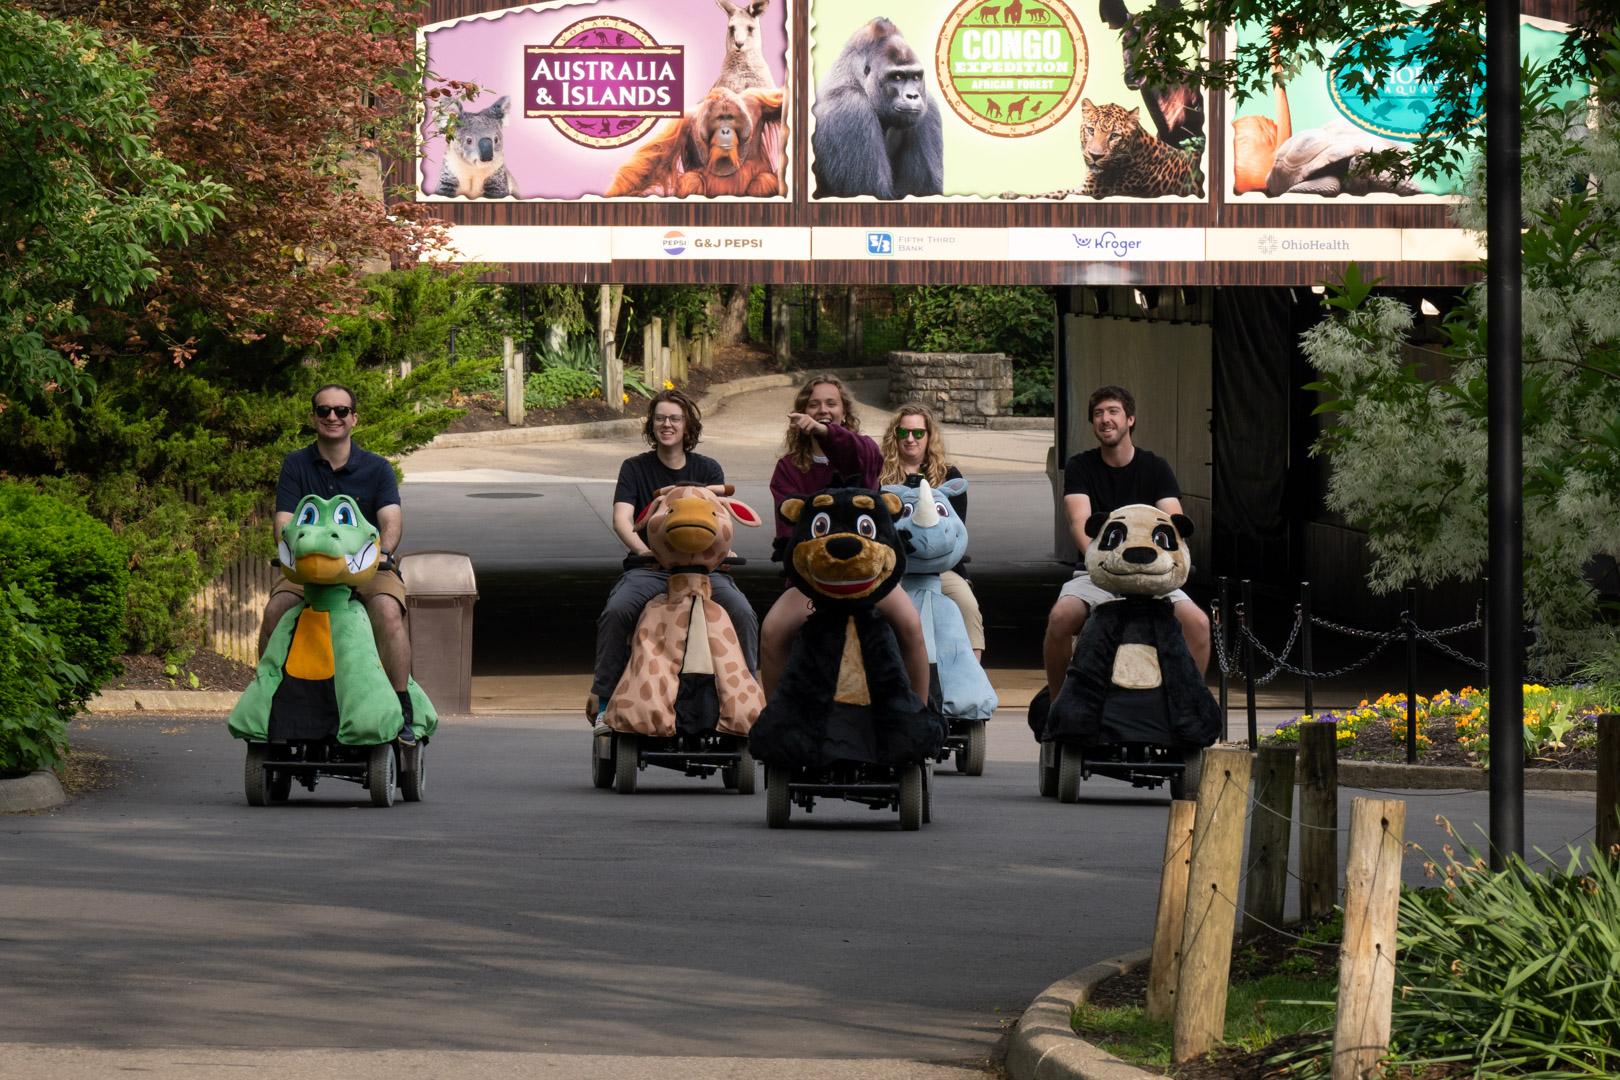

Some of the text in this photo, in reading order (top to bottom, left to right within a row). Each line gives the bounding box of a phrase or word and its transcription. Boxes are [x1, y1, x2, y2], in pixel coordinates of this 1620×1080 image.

[962, 29, 1062, 60] CONGO
[531, 58, 676, 81] AUSTRALIA
[954, 61, 1069, 73] EXPEDITION
[971, 79, 1055, 90] AFRICAN FOREST
[535, 82, 671, 106] & ISLANDS
[694, 238, 763, 248] G&J PEPSI
[898, 236, 956, 244] FIFTH THIRD
[1095, 231, 1142, 257] Kroger
[1281, 239, 1350, 250] OhioHealth
[898, 244, 924, 252] BANK
